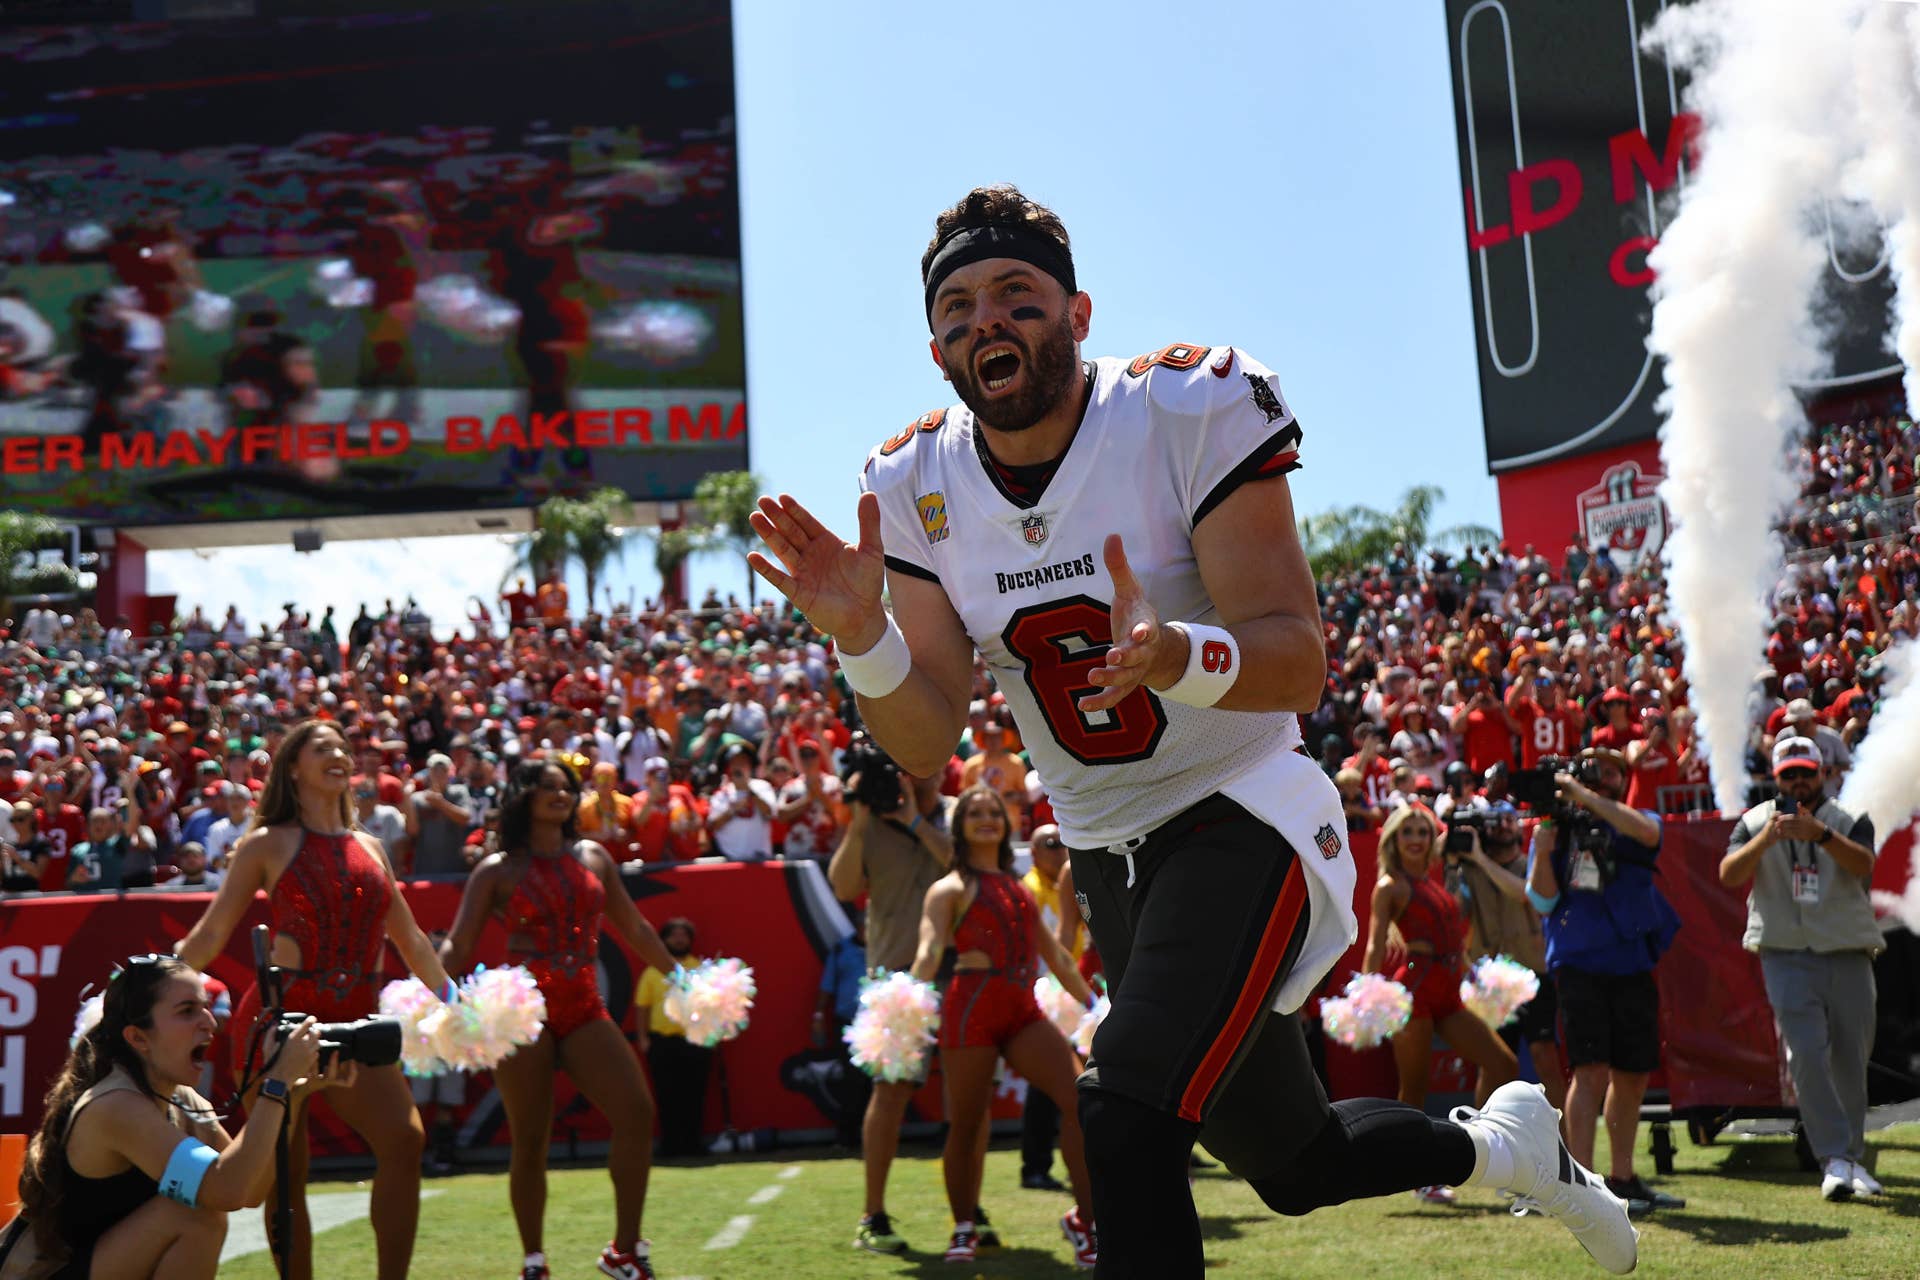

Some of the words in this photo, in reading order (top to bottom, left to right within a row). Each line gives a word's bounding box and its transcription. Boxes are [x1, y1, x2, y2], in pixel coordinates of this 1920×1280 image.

[2, 435, 85, 475] ER
[99, 420, 411, 471] MAYFIELD
[445, 407, 654, 454] BAKER
[995, 553, 1097, 594] BUCCANEERS
[1202, 640, 1232, 674] 6
[1533, 716, 1565, 752] 81
